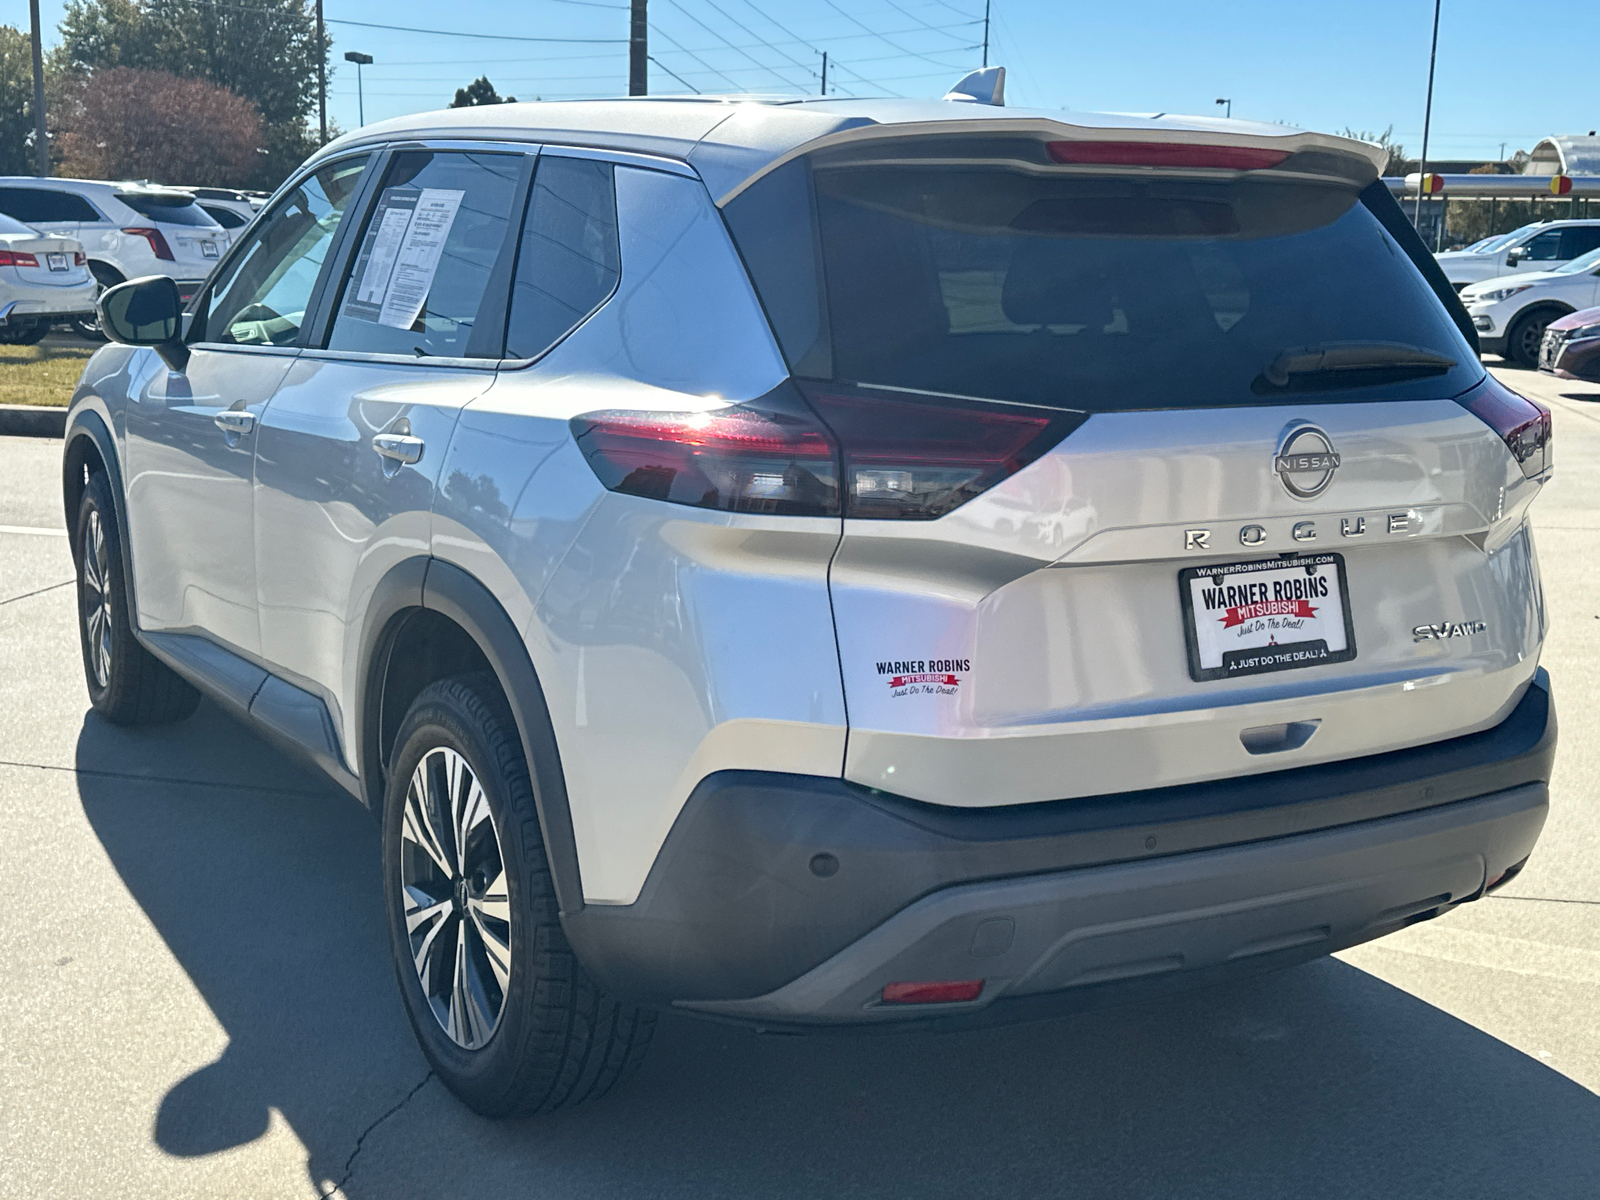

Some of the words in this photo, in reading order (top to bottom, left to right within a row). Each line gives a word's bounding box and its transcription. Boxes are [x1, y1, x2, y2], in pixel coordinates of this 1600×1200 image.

[1278, 455, 1340, 470] NISSAN
[1184, 513, 1411, 550] ROGUE
[1202, 582, 1269, 610] WARNER
[1273, 576, 1329, 601] ROBINS
[1237, 601, 1299, 620] MITSUBISHI
[1237, 623, 1254, 637] Just
[1255, 620, 1265, 632] Do
[1267, 618, 1280, 630] The
[1281, 619, 1305, 630] Deal!
[1412, 621, 1450, 643] SV
[876, 661, 925, 675] WARNER
[929, 659, 970, 673] ROBINS
[1238, 659, 1260, 669] JUST
[1260, 656, 1274, 665] DO
[1274, 654, 1293, 664] THE
[1293, 650, 1319, 660] DEAL!
[901, 674, 948, 684] MITSUBISHI
[891, 688, 908, 698] Just
[909, 685, 920, 695] Do
[921, 685, 934, 694] The
[935, 685, 958, 696] Deal!
